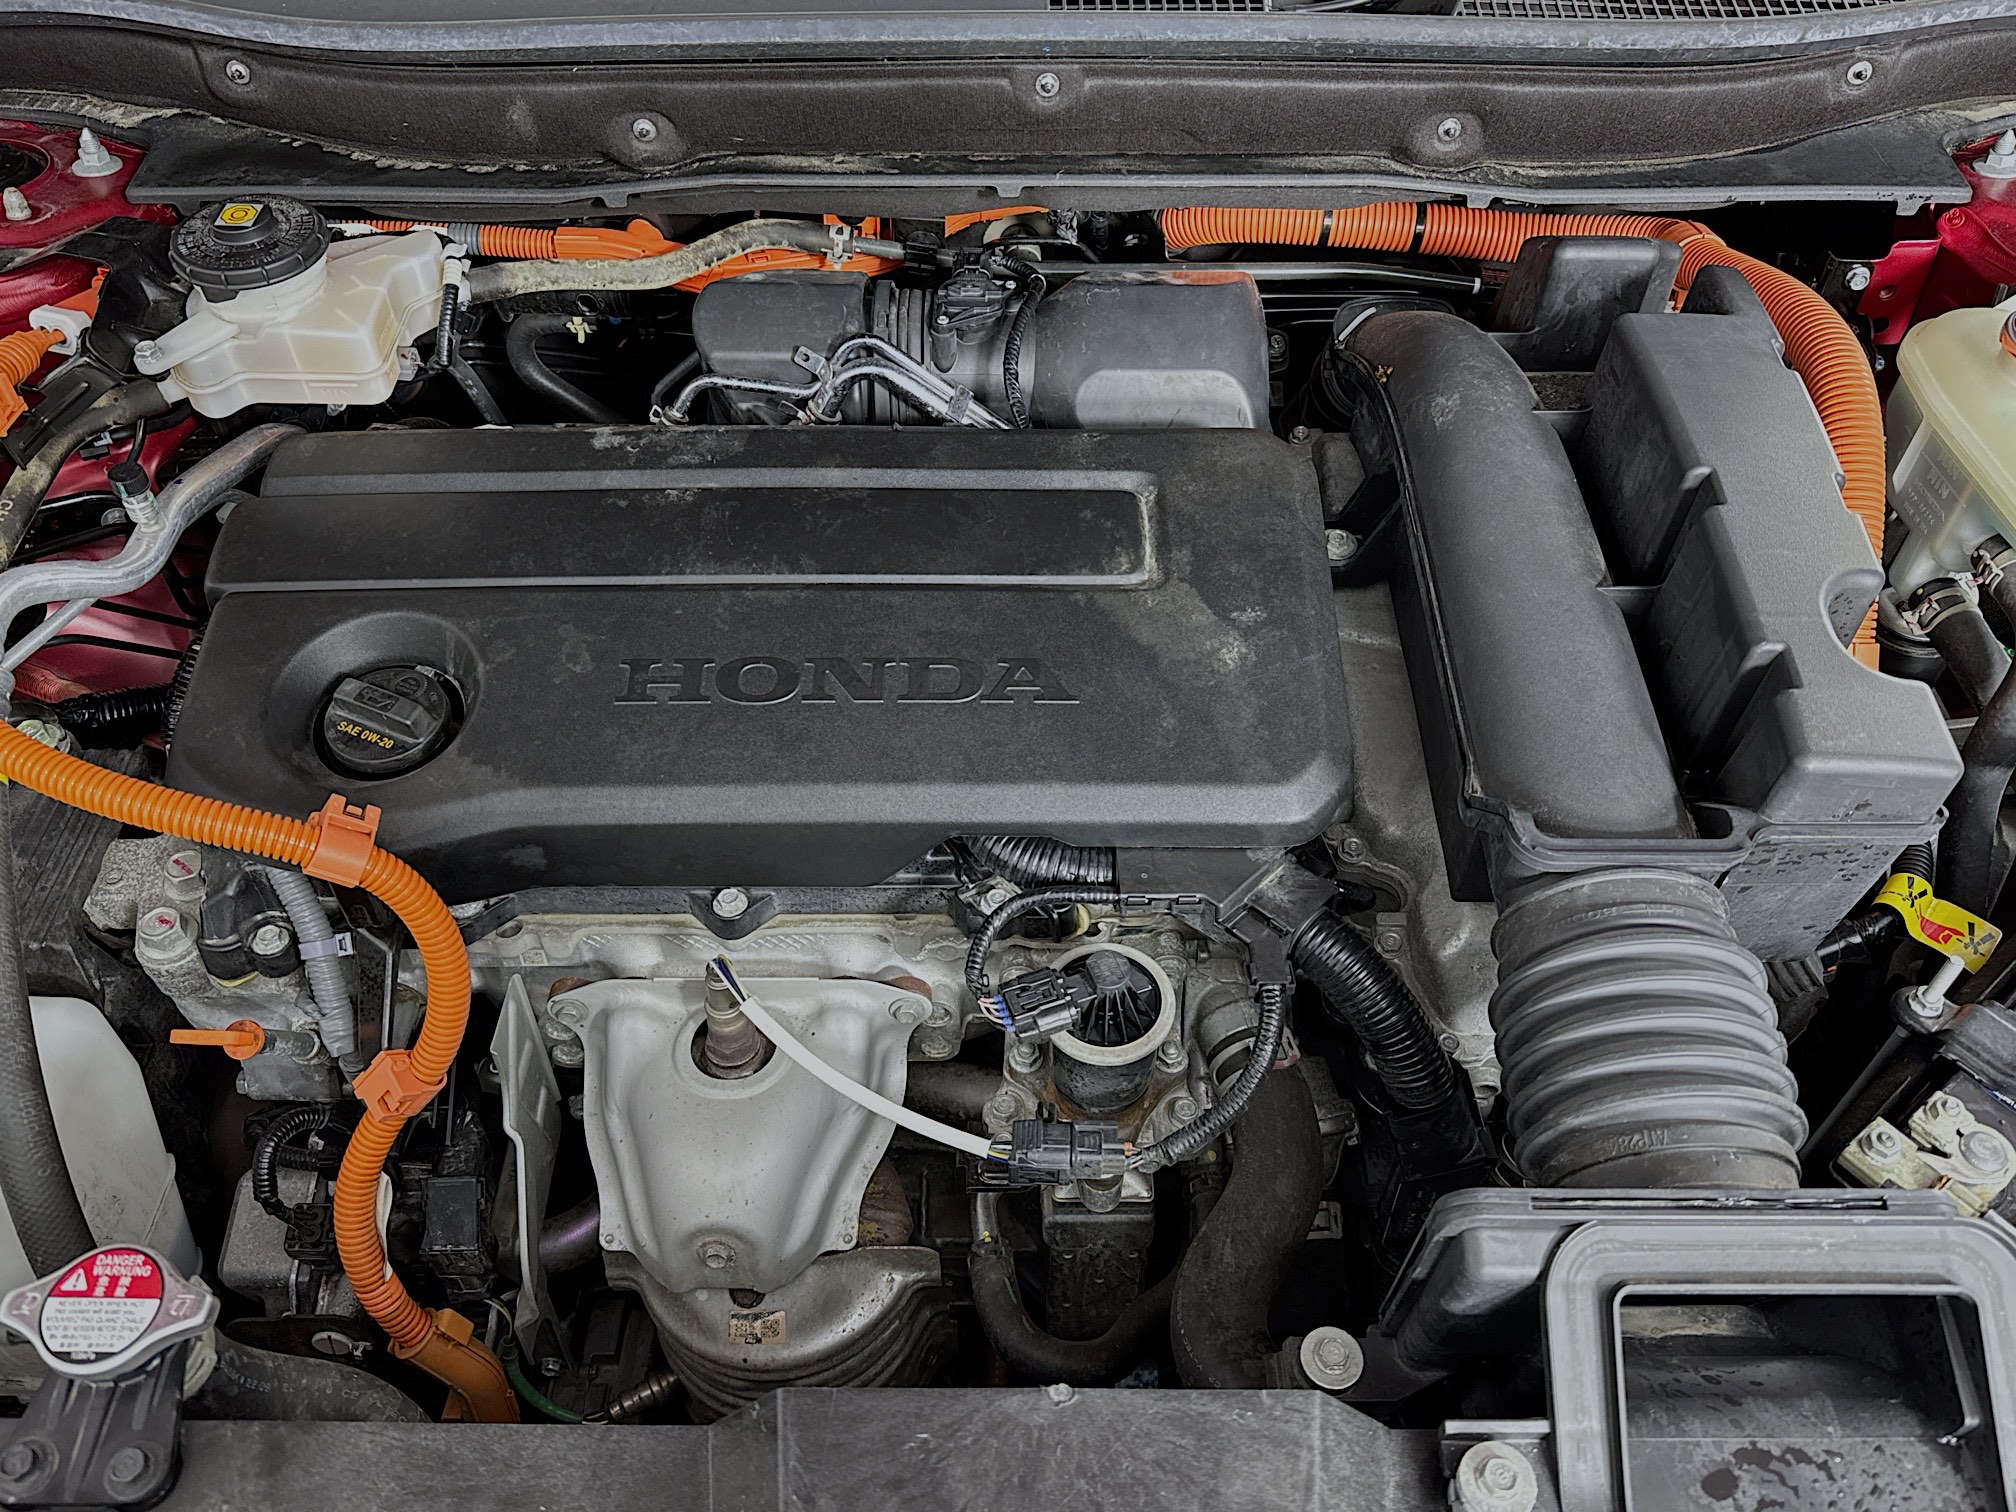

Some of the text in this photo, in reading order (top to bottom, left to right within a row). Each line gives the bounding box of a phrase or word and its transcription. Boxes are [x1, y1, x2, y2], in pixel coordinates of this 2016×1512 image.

[614, 656, 1080, 704] HONDA
[337, 720, 362, 736] SAE
[360, 729, 394, 749] 0W-20
[95, 1254, 145, 1266] DANGER
[92, 1265, 152, 1277] WARNUNG
